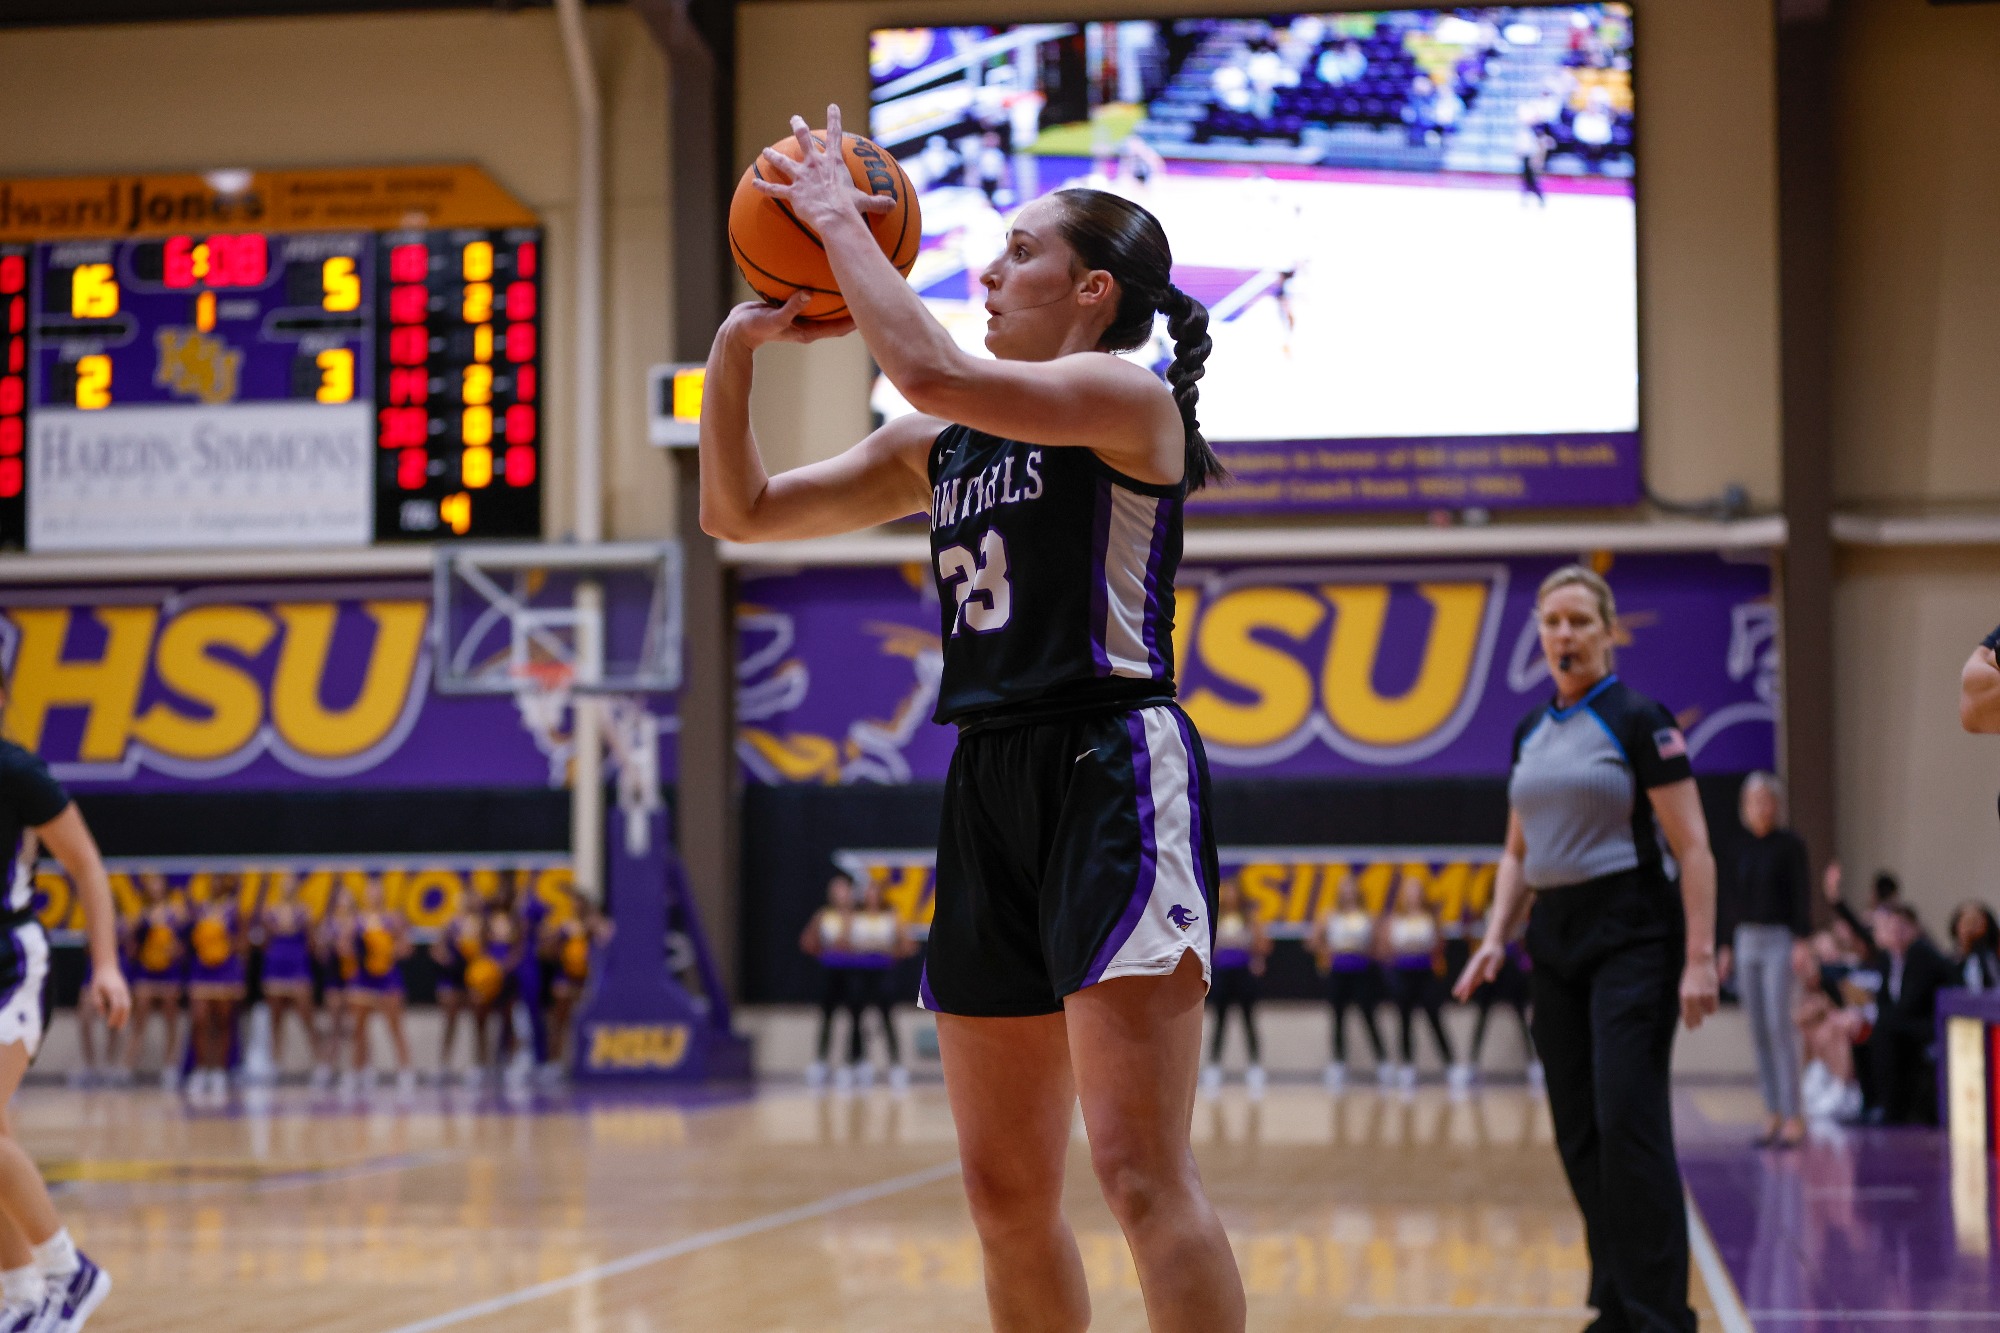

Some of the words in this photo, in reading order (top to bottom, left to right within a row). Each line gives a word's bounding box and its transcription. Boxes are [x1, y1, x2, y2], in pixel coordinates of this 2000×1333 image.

[853, 136, 898, 203] Wils
[322, 256, 361, 312] 5
[76, 354, 113, 410] 2
[316, 348, 354, 404] 3
[930, 450, 1044, 533] OWIRLS
[937, 527, 1012, 637] 23
[2, 601, 429, 762] HSU
